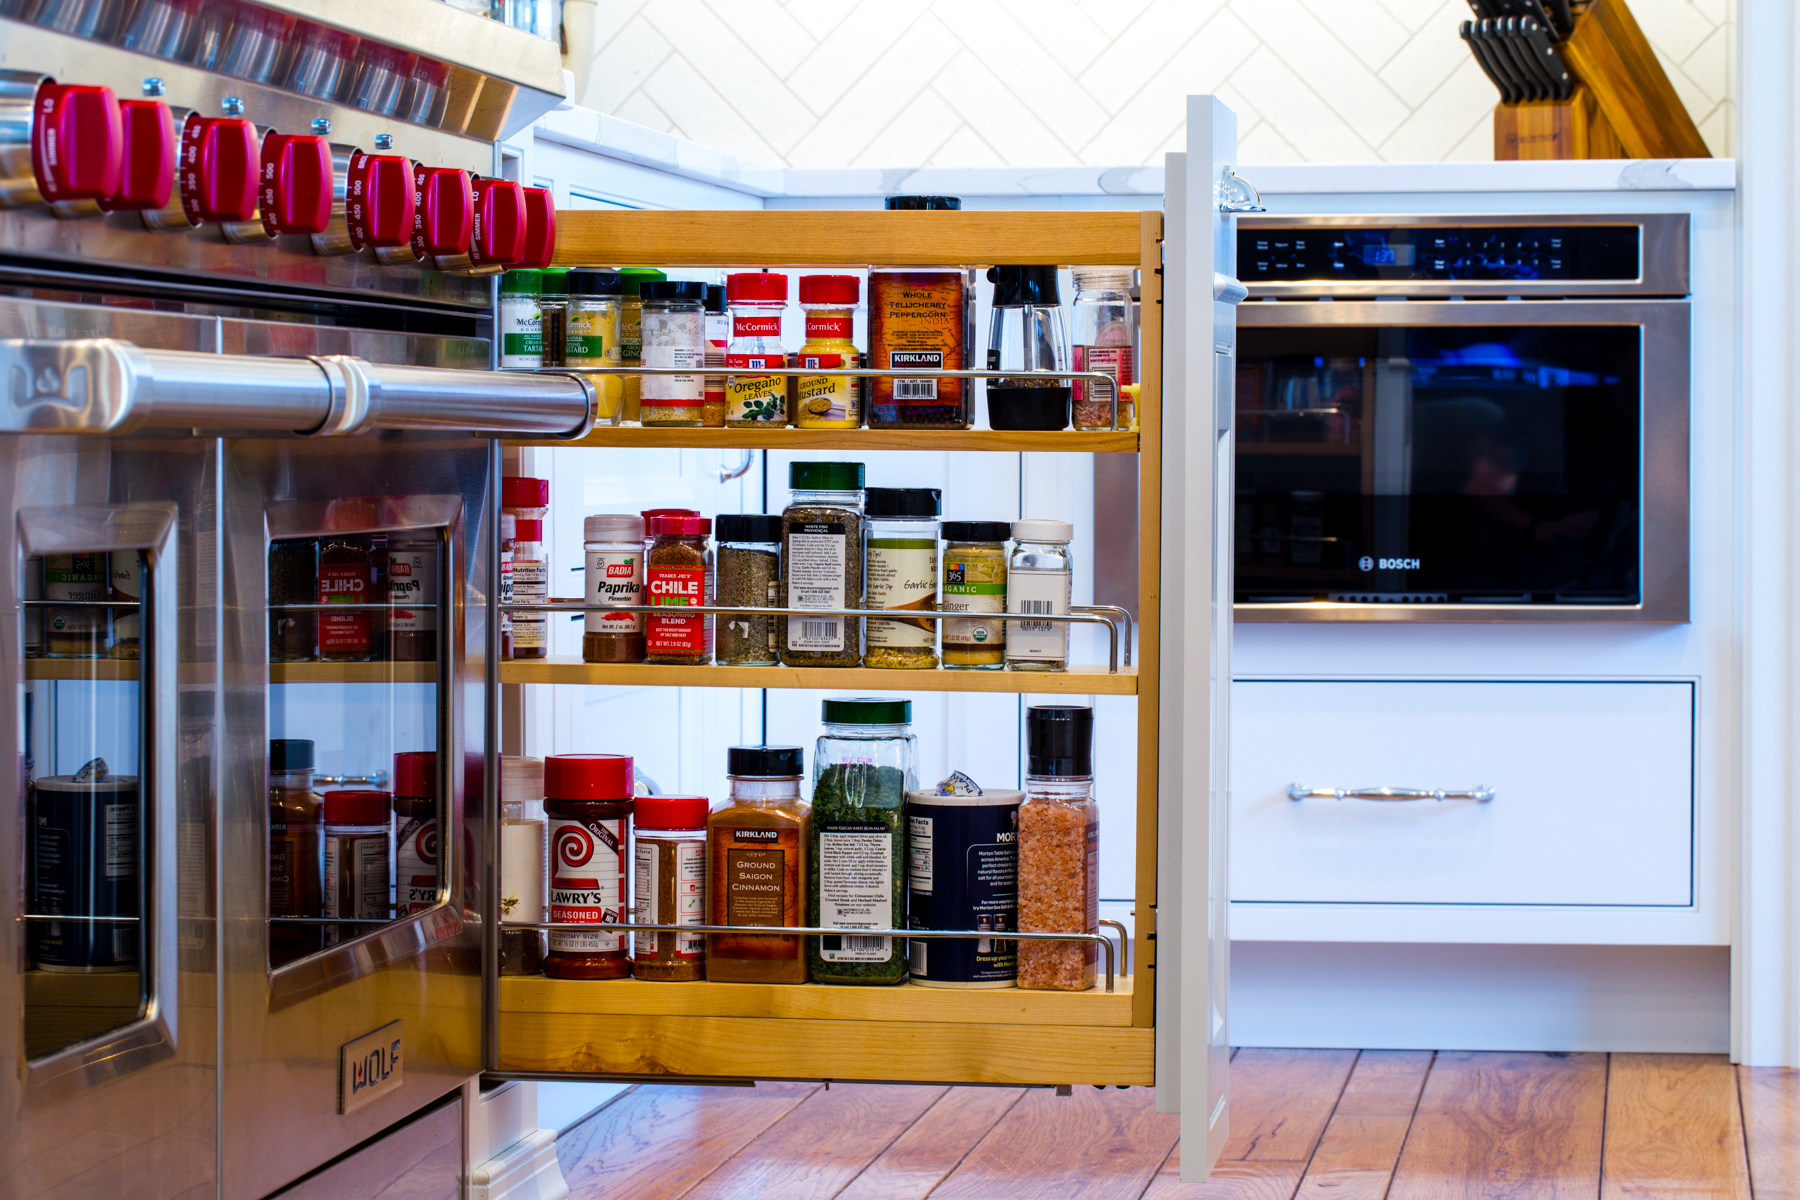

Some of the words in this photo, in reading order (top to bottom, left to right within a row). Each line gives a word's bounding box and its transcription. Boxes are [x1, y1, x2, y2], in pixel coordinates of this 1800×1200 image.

[188, 146, 197, 164] 400
[266, 163, 275, 180] 500
[353, 180, 362, 196] 500
[266, 188, 274, 206] 450
[353, 204, 361, 220] 450
[903, 291, 933, 299] WHOLE
[889, 301, 946, 310] TELLICHERRY
[735, 322, 780, 332] McCormick
[894, 354, 940, 362] KIRKLAND
[734, 377, 781, 394] Oregano
[800, 382, 835, 401] ustard
[744, 389, 773, 401] LEAVES
[1378, 558, 1420, 569] BOSCH
[608, 566, 632, 576] BADIA
[948, 570, 962, 581] 365
[597, 581, 640, 596] Paprika
[651, 581, 699, 595] CHILE
[903, 579, 928, 590] Garlic
[942, 600, 969, 612] Ginger
[588, 823, 613, 847] ORIGINAL
[735, 830, 777, 839] KIRKLAND
[736, 861, 776, 869] GROUND
[739, 872, 773, 880] SAIGON
[731, 883, 780, 892] CINNAMON
[550, 890, 602, 904] LAWRY'S
[553, 910, 598, 920] SEASONED
[352, 1038, 401, 1096] WOLF
